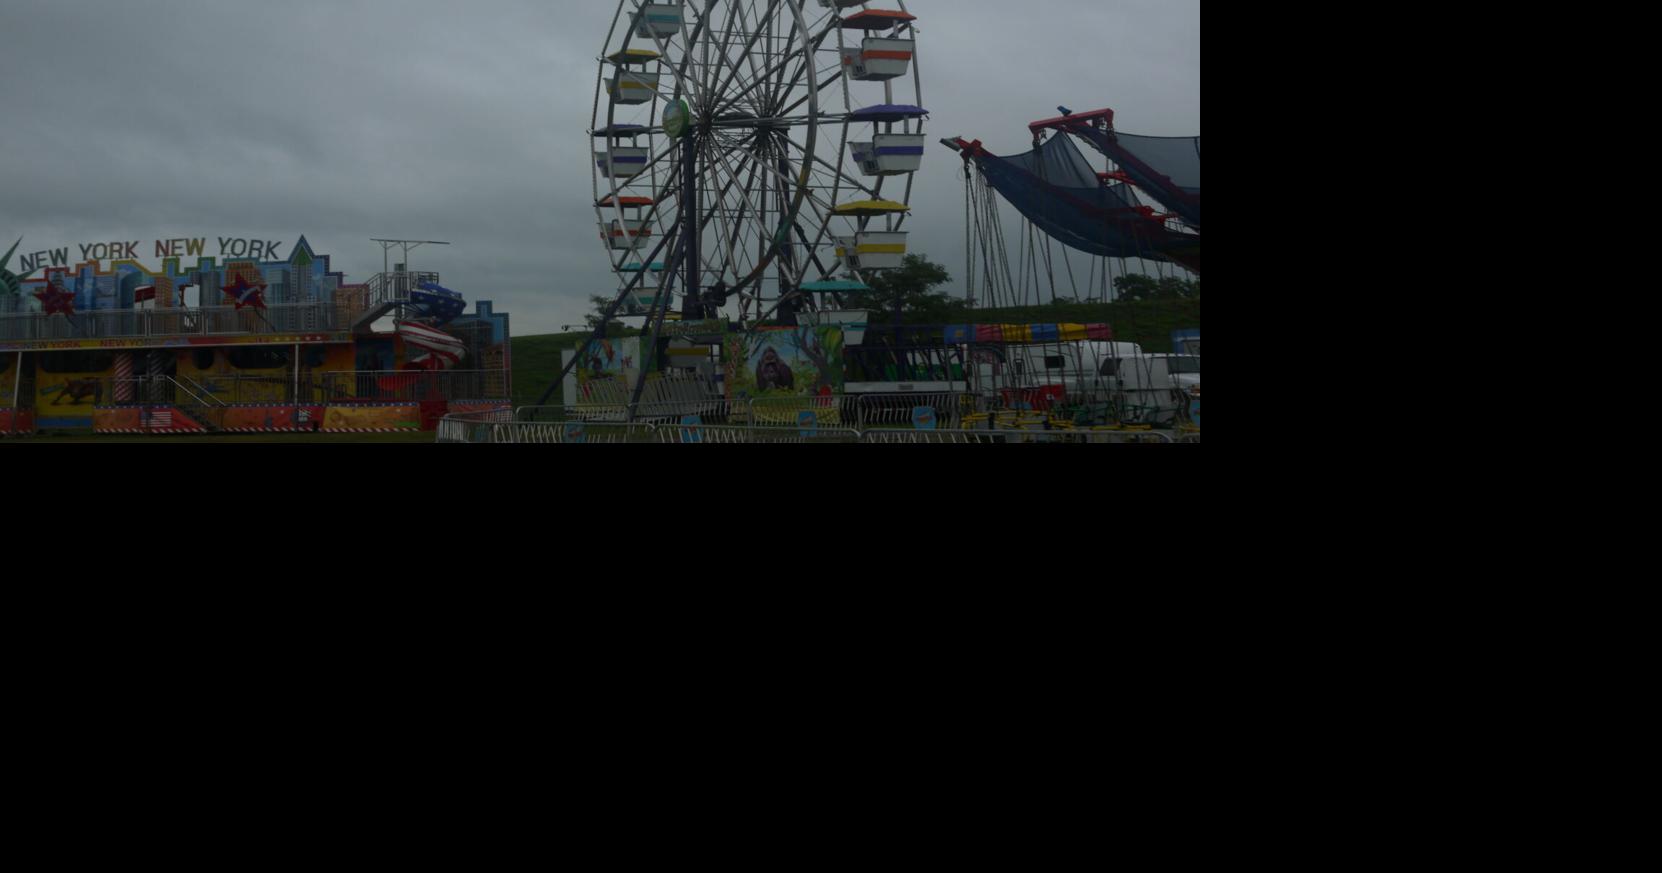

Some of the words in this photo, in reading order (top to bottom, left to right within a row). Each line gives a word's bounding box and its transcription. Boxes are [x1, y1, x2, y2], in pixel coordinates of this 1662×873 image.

[20, 247, 68, 272] NEW
[78, 240, 138, 261] YORK
[155, 237, 205, 258] NEW
[217, 236, 281, 260] YORK
